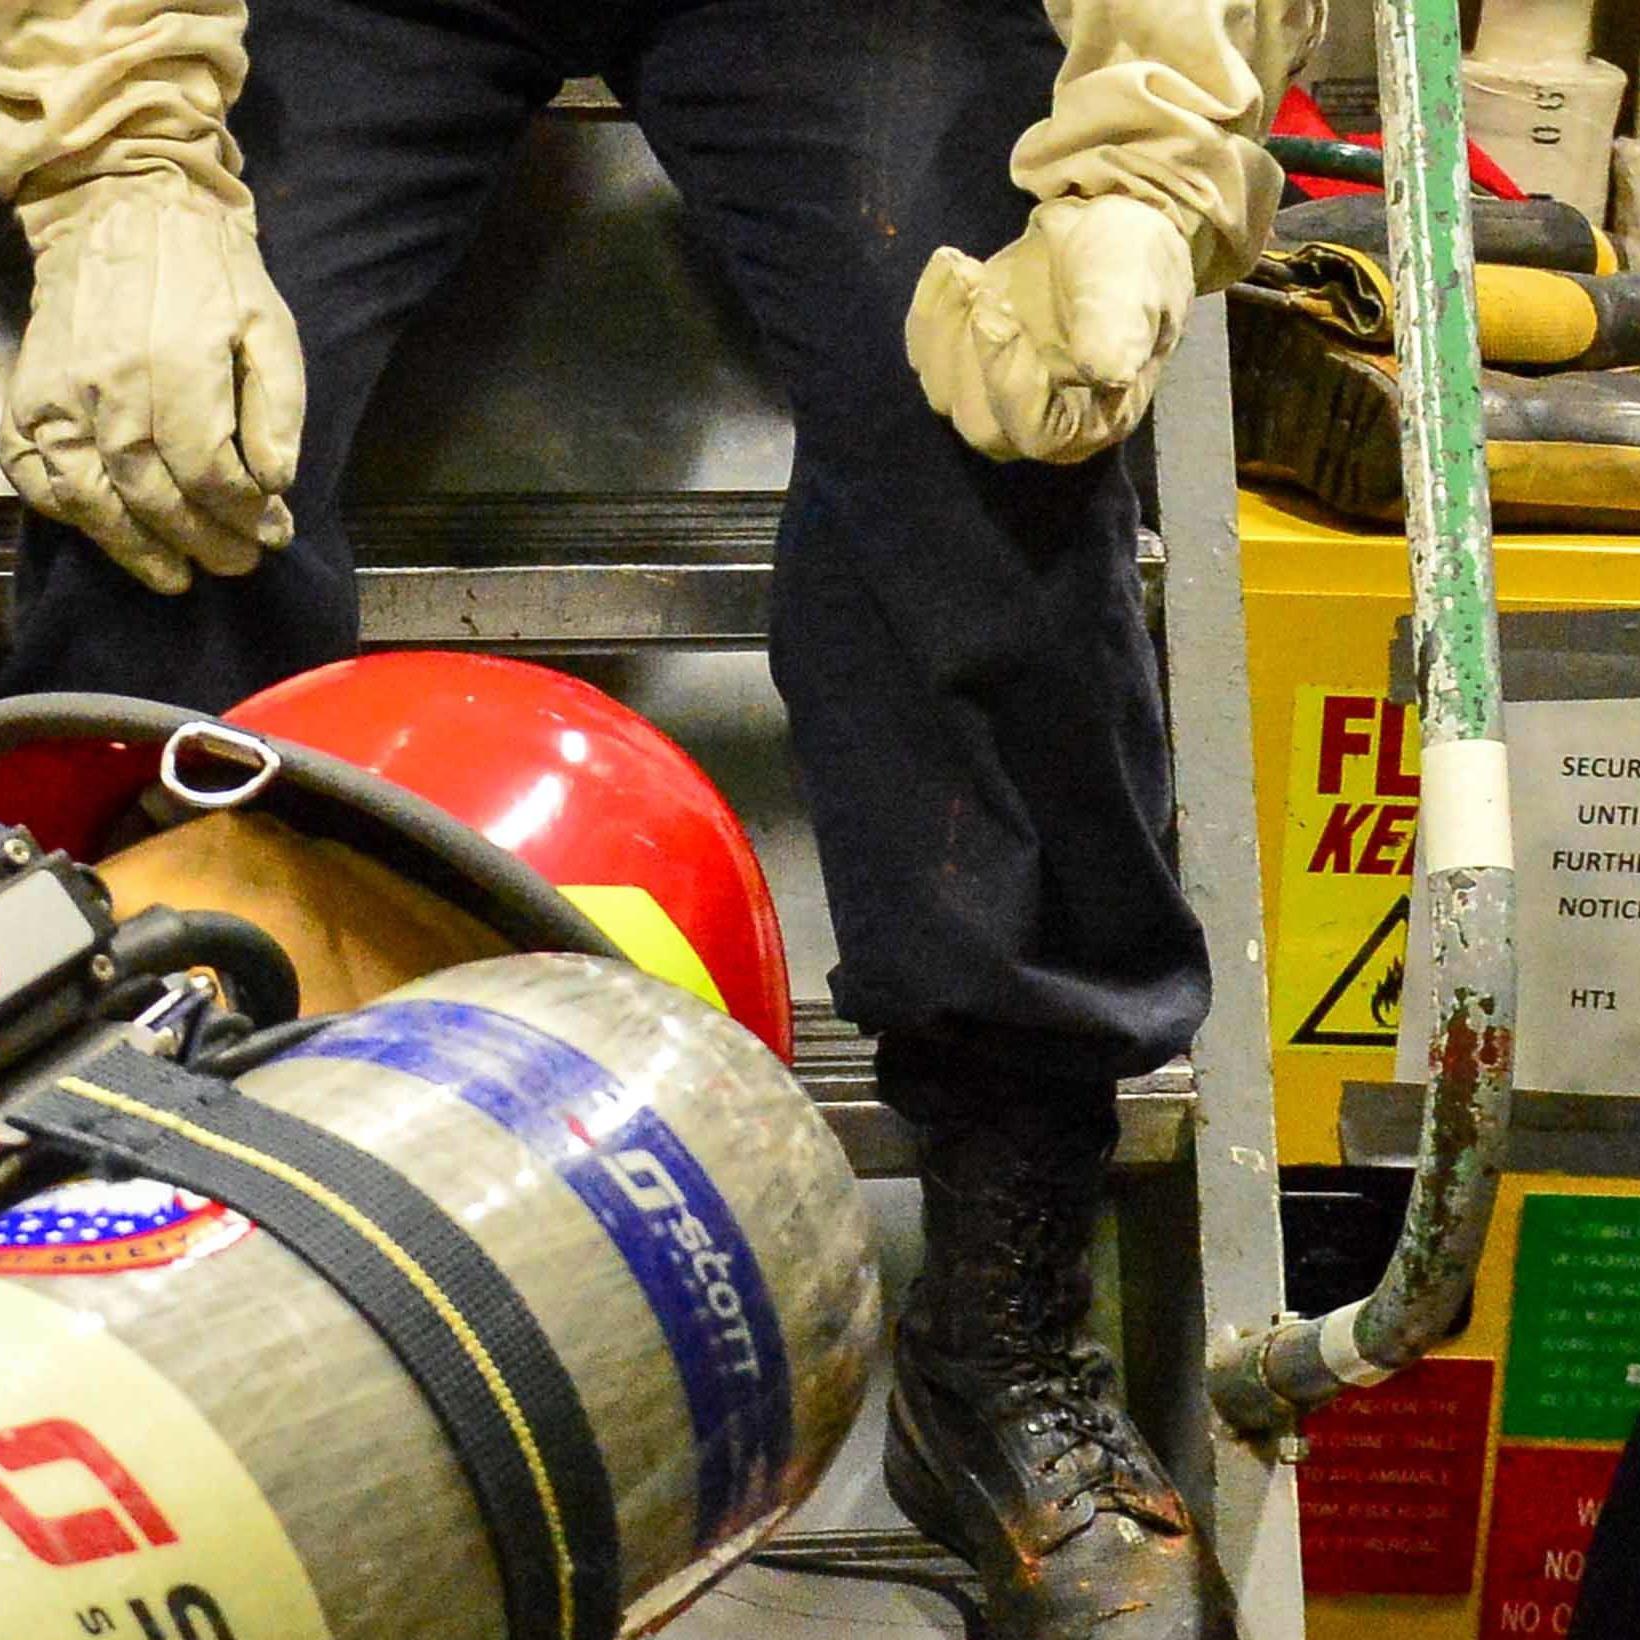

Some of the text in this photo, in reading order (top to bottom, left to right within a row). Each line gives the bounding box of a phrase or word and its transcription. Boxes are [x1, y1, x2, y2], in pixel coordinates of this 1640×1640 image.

[1306, 803, 1419, 876] KE
[1570, 989, 1617, 1011] HT1
[666, 1205, 762, 1377] SCOTT
[1545, 1550, 1586, 1582] NO
[1500, 1602, 1541, 1633] NO
